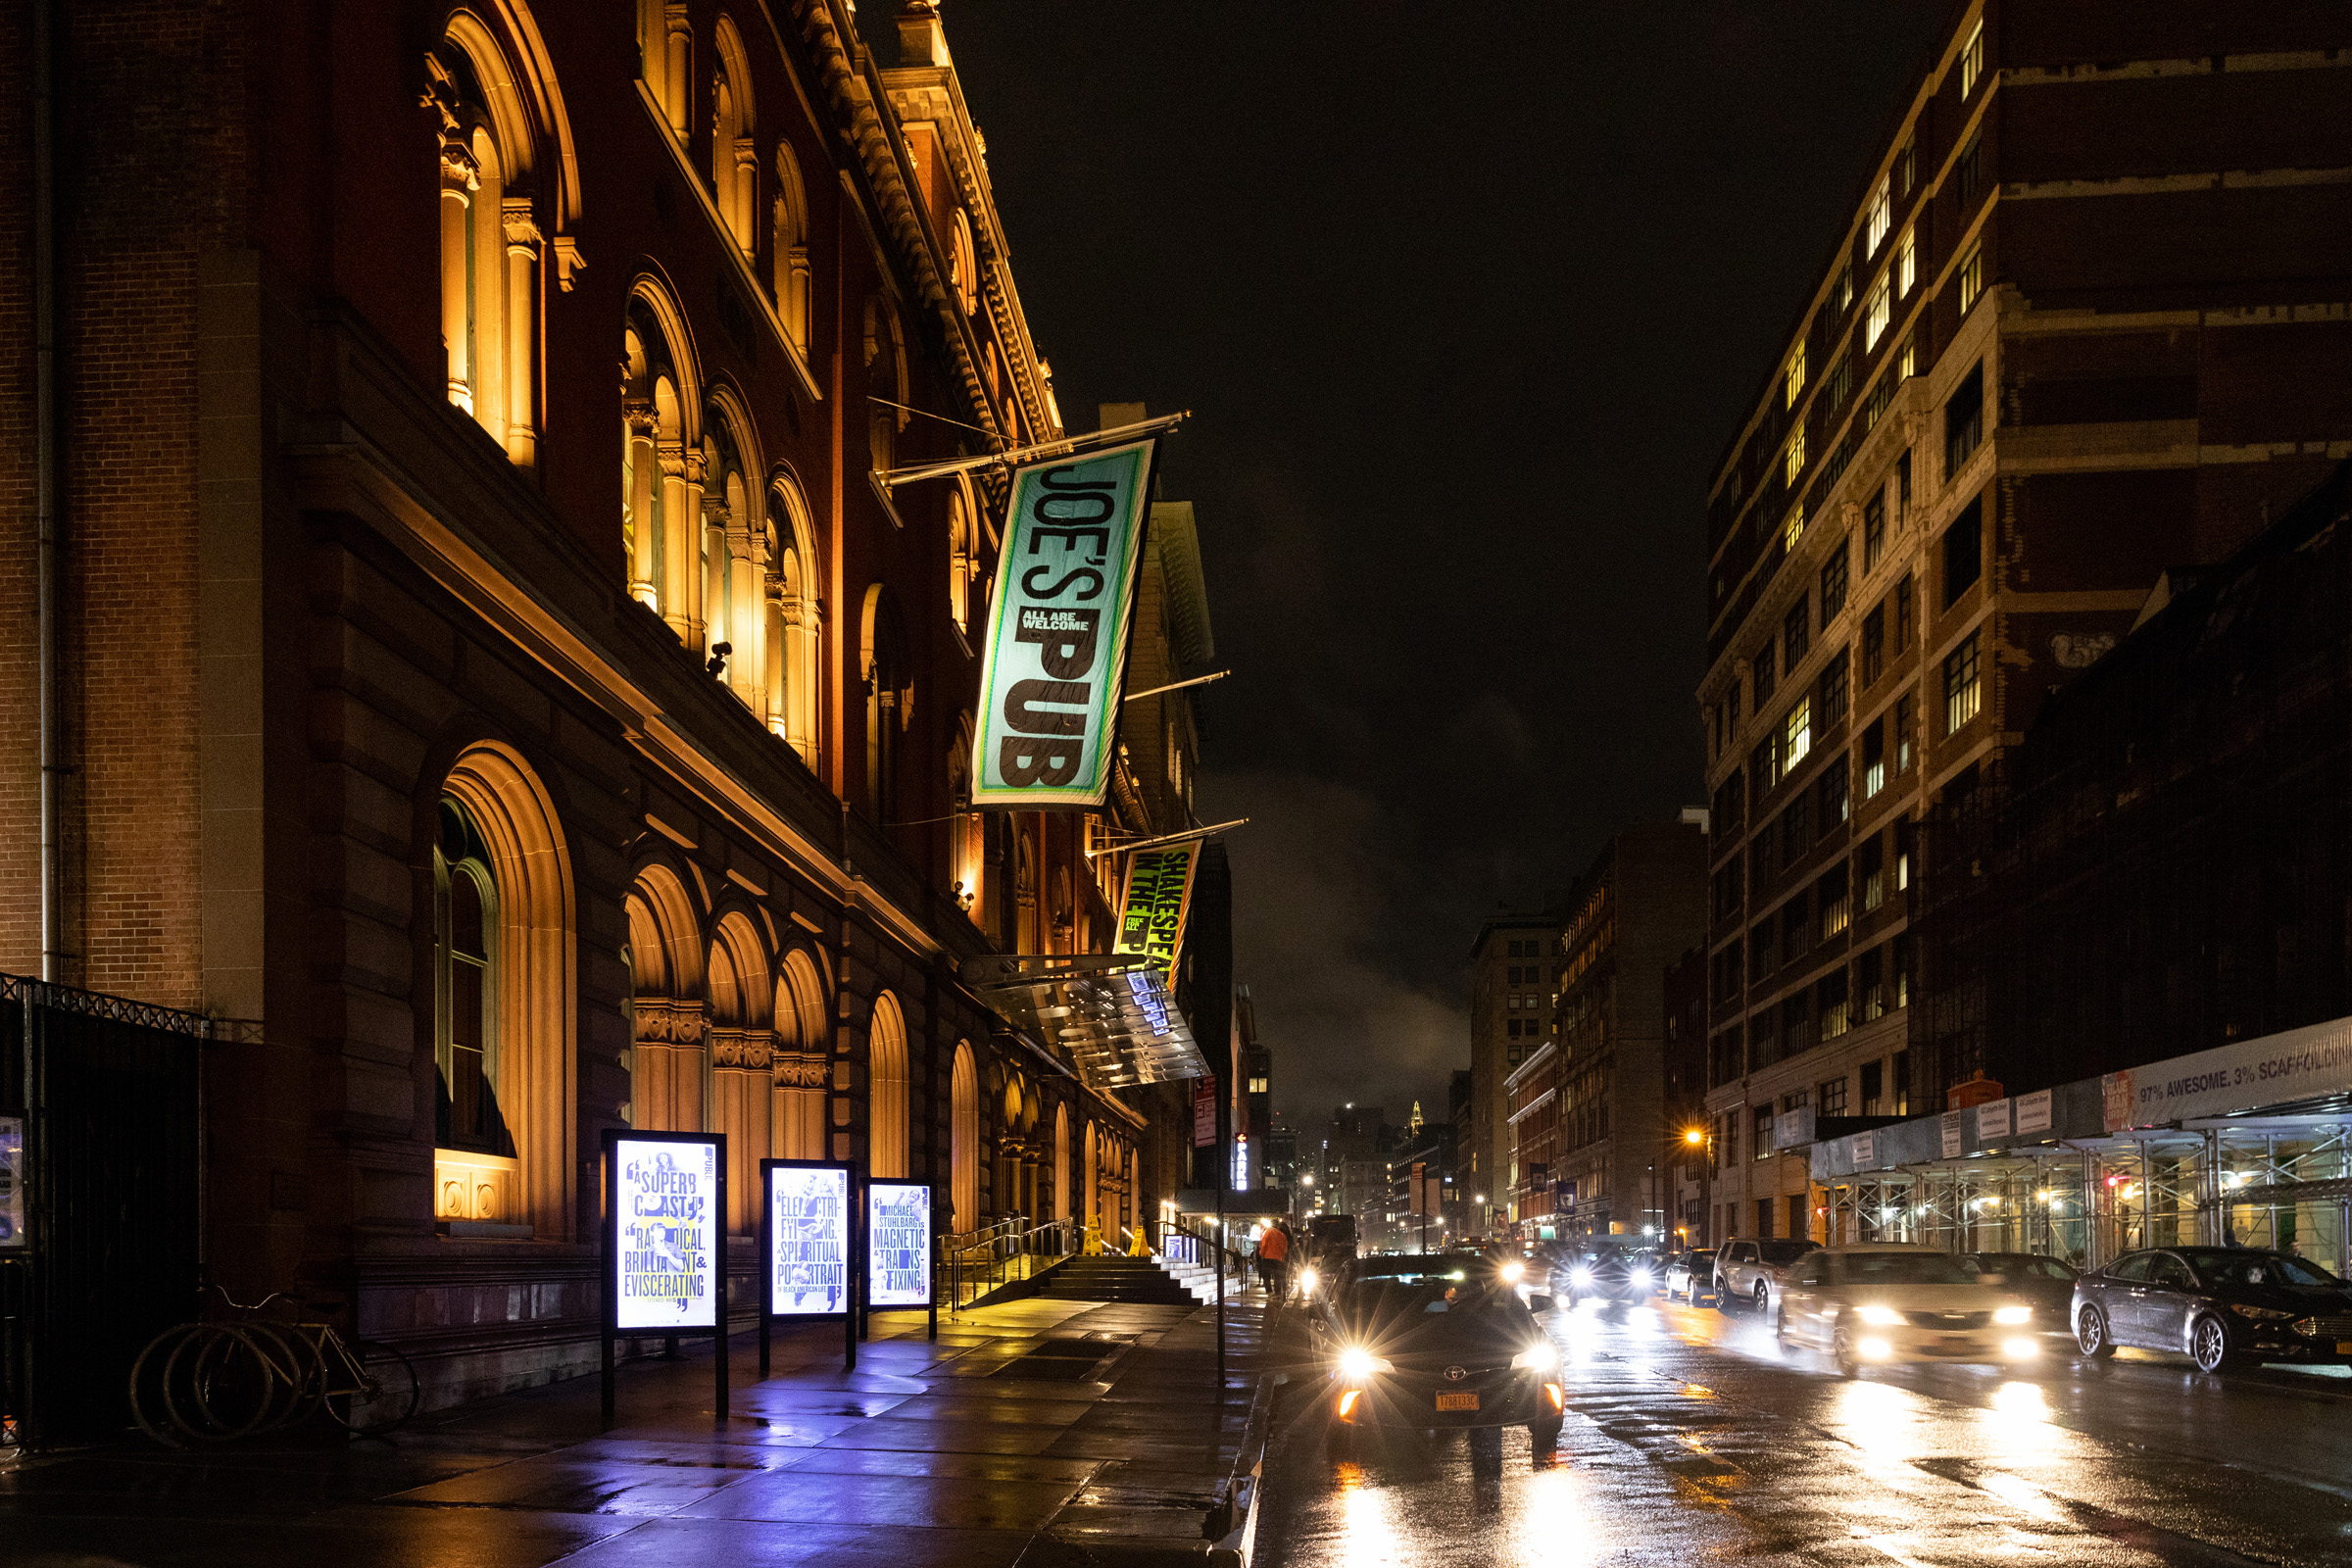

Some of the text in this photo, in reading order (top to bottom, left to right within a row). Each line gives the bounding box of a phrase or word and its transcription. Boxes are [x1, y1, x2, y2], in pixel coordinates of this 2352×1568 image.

[1021, 465, 1117, 602] JOE'S
[1022, 610, 1076, 621] ALL ARE
[1022, 618, 1089, 631] WELCOME
[999, 606, 1102, 788] PUB
[1134, 853, 1163, 870] IN
[1126, 874, 1159, 913] THE
[2140, 1085, 2163, 1102] 97%
[2167, 1070, 2230, 1098] AWESOME.
[2234, 1065, 2255, 1085] 3%
[641, 1171, 697, 1195] SUPERB
[874, 1228, 925, 1249] MAGNETIC
[780, 1241, 841, 1262] SPIRITUAL
[777, 1263, 843, 1285] PORTRAIT
